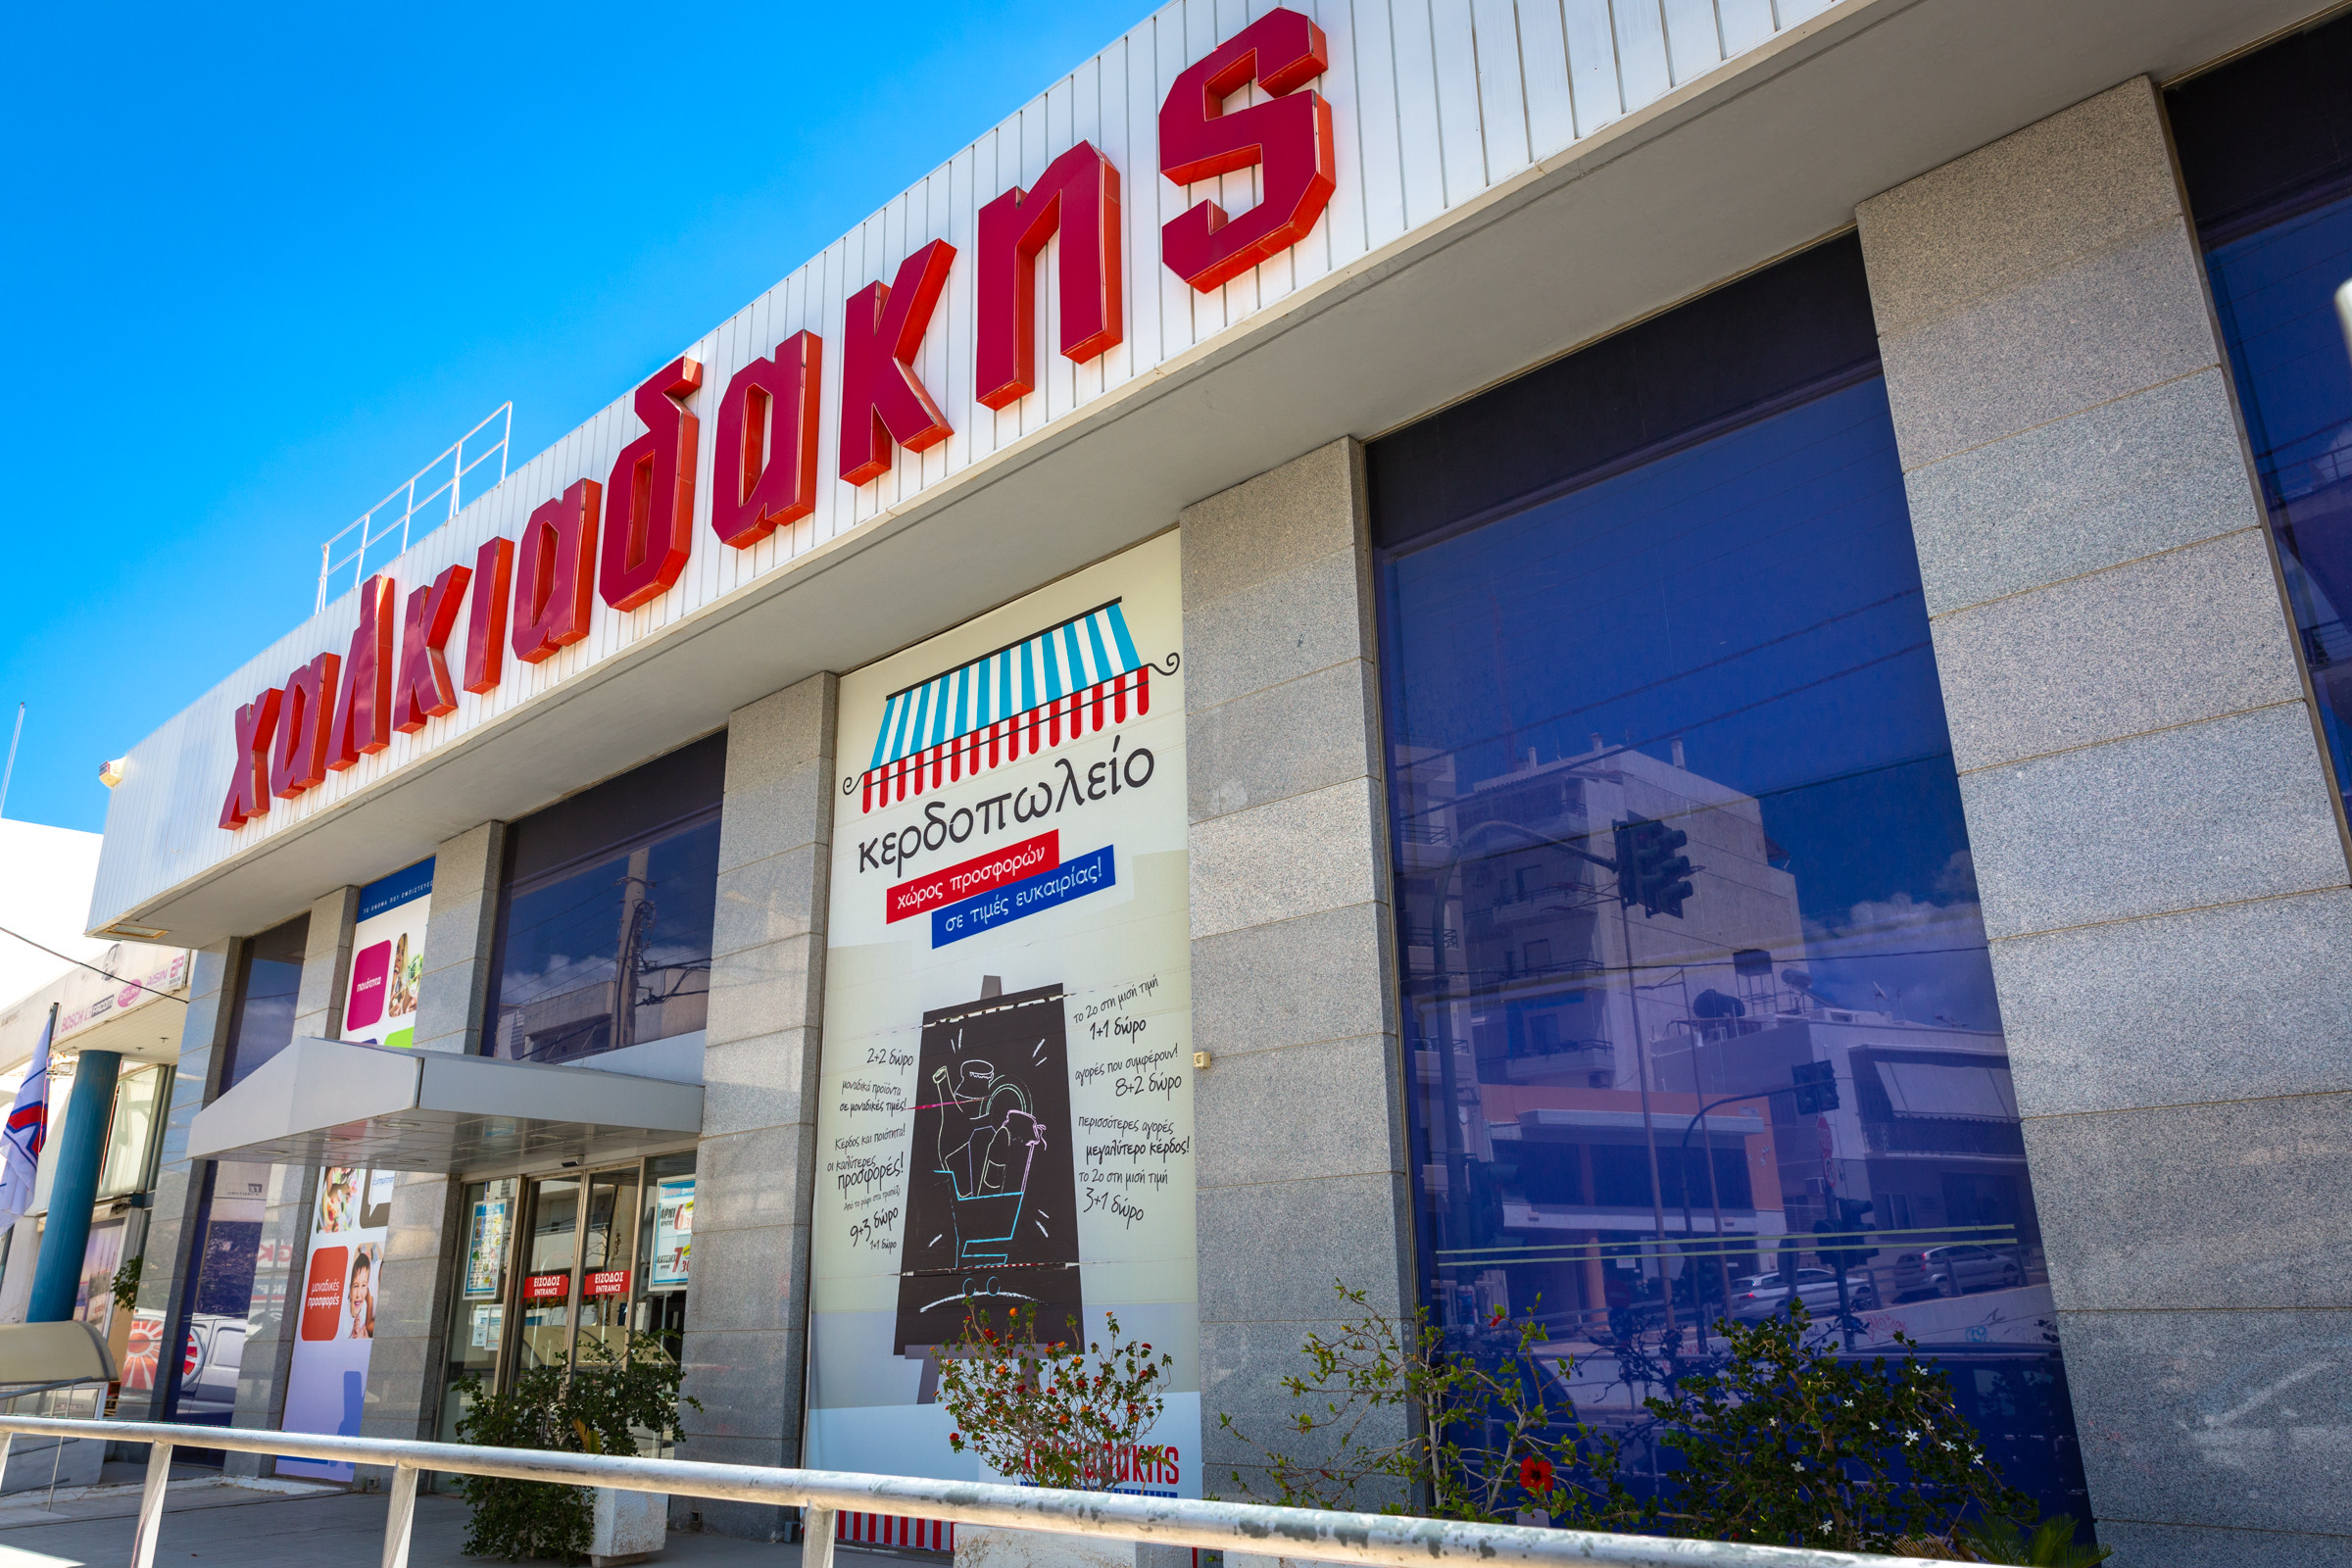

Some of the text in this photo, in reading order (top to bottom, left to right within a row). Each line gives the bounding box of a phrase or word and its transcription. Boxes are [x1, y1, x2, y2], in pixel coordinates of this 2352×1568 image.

[858, 734, 1154, 878] κερδοπωλείο
[897, 844, 1046, 909] χώρος προσφορών
[945, 856, 1102, 932] σε τιμές ευκαιρίας!
[1073, 1013, 1084, 1023] το
[1101, 997, 1116, 1011] στη
[1117, 984, 1138, 1010] μισή
[1139, 974, 1158, 997] τιμή
[61, 1008, 84, 1033] BOSCH
[1089, 1015, 1147, 1044] 1+1 δώρο
[866, 1048, 914, 1076] 2+2 δώρο
[1075, 1042, 1178, 1087] αγορές που συμφέρουν!
[841, 1078, 870, 1096] μοναδικά
[1115, 1071, 1182, 1102] 8+2 δώρο
[839, 1097, 907, 1118] σε μοναδικές τιμές!
[835, 1122, 906, 1155] Κέρδος και ποιότητα!
[1078, 1114, 1174, 1141] περισσότερες αγορές
[836, 1155, 876, 1172] καλύτερες
[1086, 1135, 1190, 1165] μεγαλύτερο κέρδος!
[838, 1151, 904, 1200] προσφορές!
[1078, 1171, 1090, 1182] το
[1106, 1172, 1123, 1184] στη
[1125, 1169, 1146, 1191] μισή
[1149, 1169, 1168, 1192] τιμή
[1083, 1187, 1144, 1230] 3+1 δώρο
[850, 1207, 899, 1248] 9+3 δώρο
[881, 1238, 898, 1256] δώρο
[311, 1278, 340, 1295] μοναδικές
[533, 1276, 561, 1287] ΕΙΣΟΔΟΣ
[594, 1271, 624, 1284] ΕΙΣΟΔΟΣ
[595, 1284, 621, 1294] ENTRANCE
[308, 1293, 340, 1309] προσφορές
